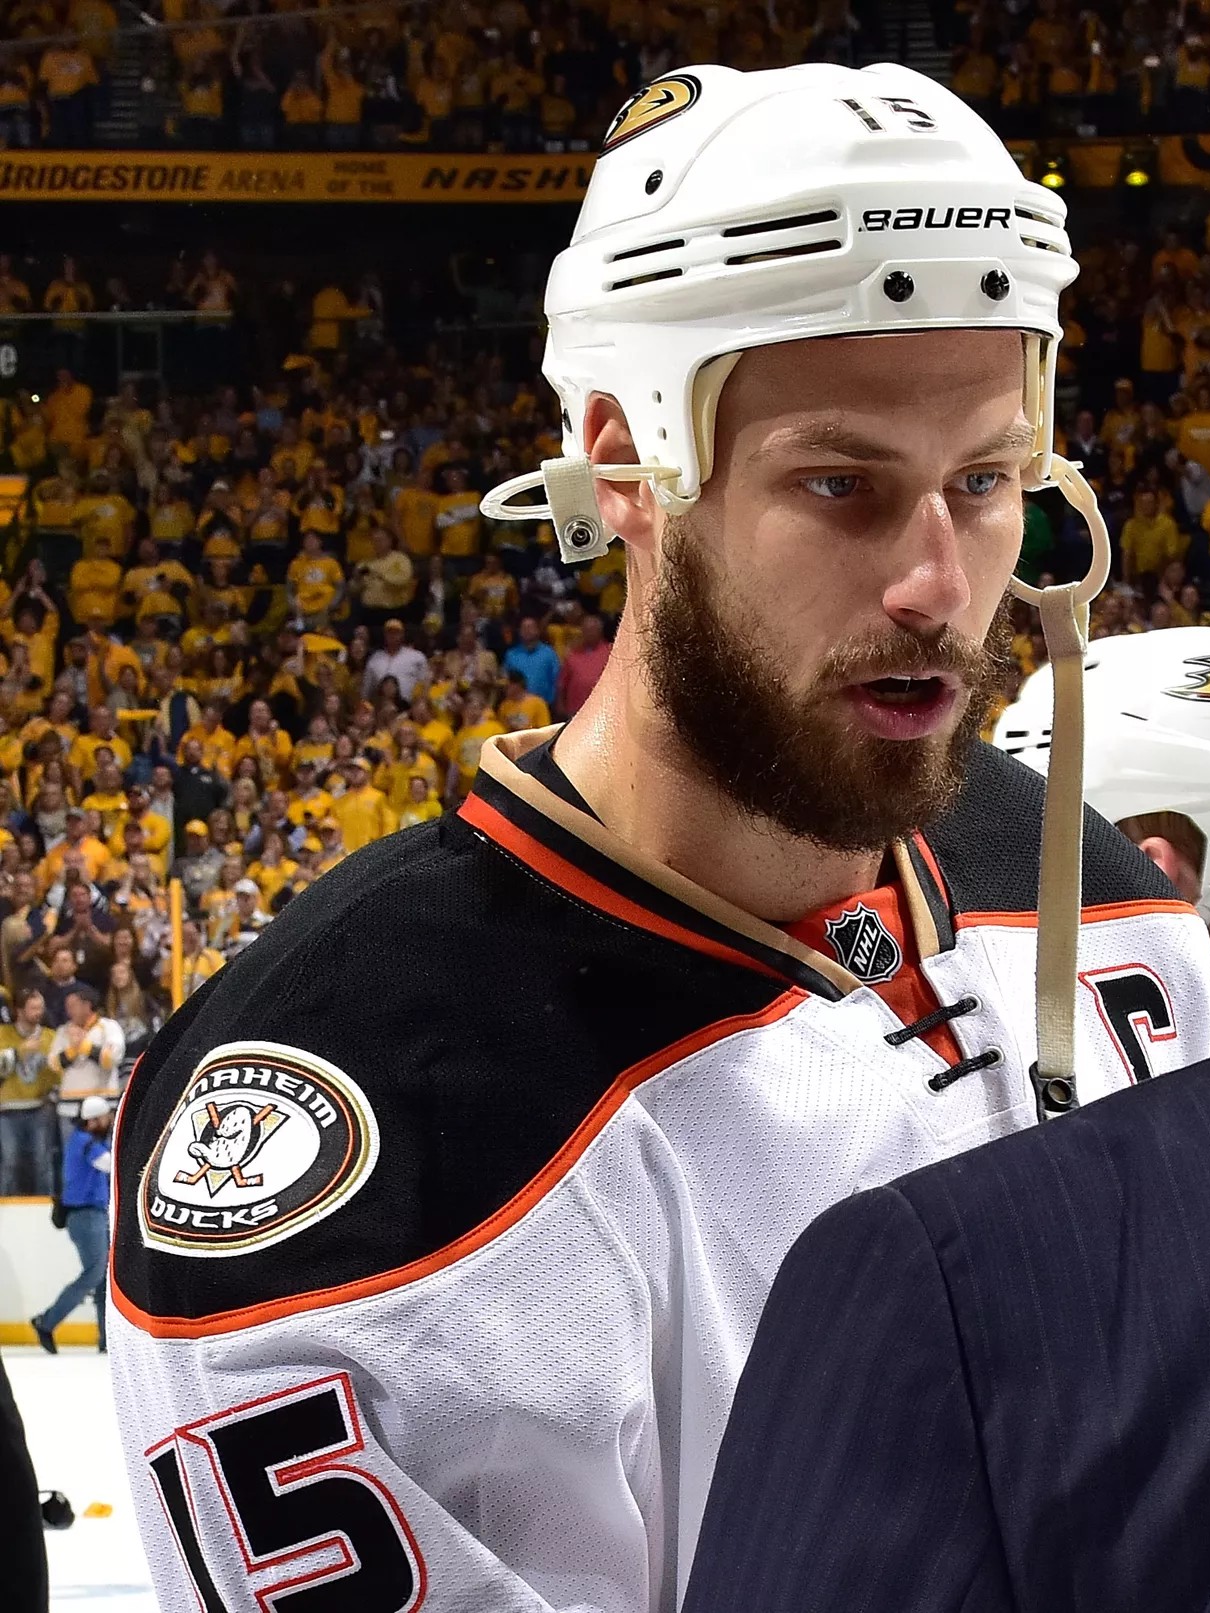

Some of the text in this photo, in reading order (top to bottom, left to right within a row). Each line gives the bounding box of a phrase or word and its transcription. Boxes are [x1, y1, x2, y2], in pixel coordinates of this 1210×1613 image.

[833, 96, 940, 133] 15
[218, 164, 305, 192] ARENA
[853, 923, 878, 973] NHL
[172, 1066, 338, 1130] NAHEIM
[149, 1196, 280, 1229] DUCKS
[144, 1371, 429, 1613] 15
